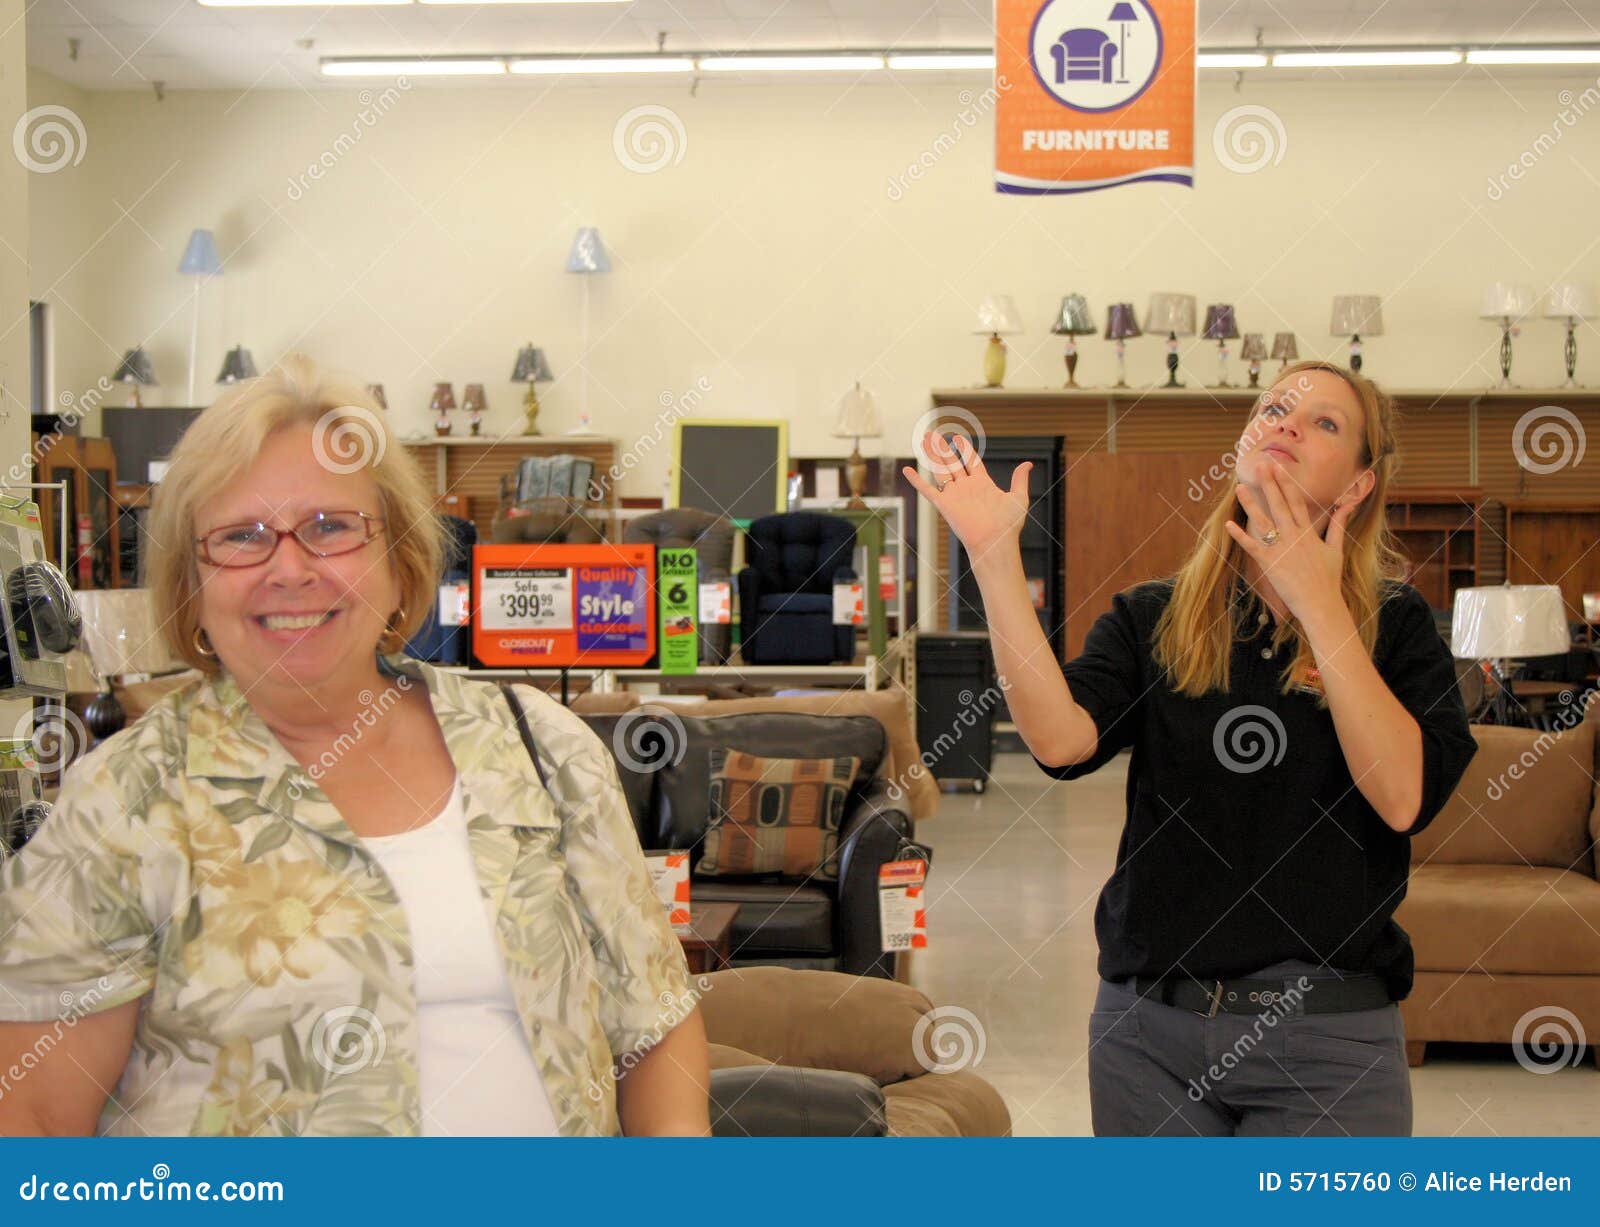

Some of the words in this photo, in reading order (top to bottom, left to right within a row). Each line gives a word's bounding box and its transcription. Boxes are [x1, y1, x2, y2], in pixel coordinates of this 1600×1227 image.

[1023, 129, 1169, 151] FURNITURE
[662, 554, 693, 567] NO
[514, 580, 539, 592] Sofa
[580, 567, 636, 587] Quality
[669, 583, 688, 604] 6
[580, 594, 635, 621] Style
